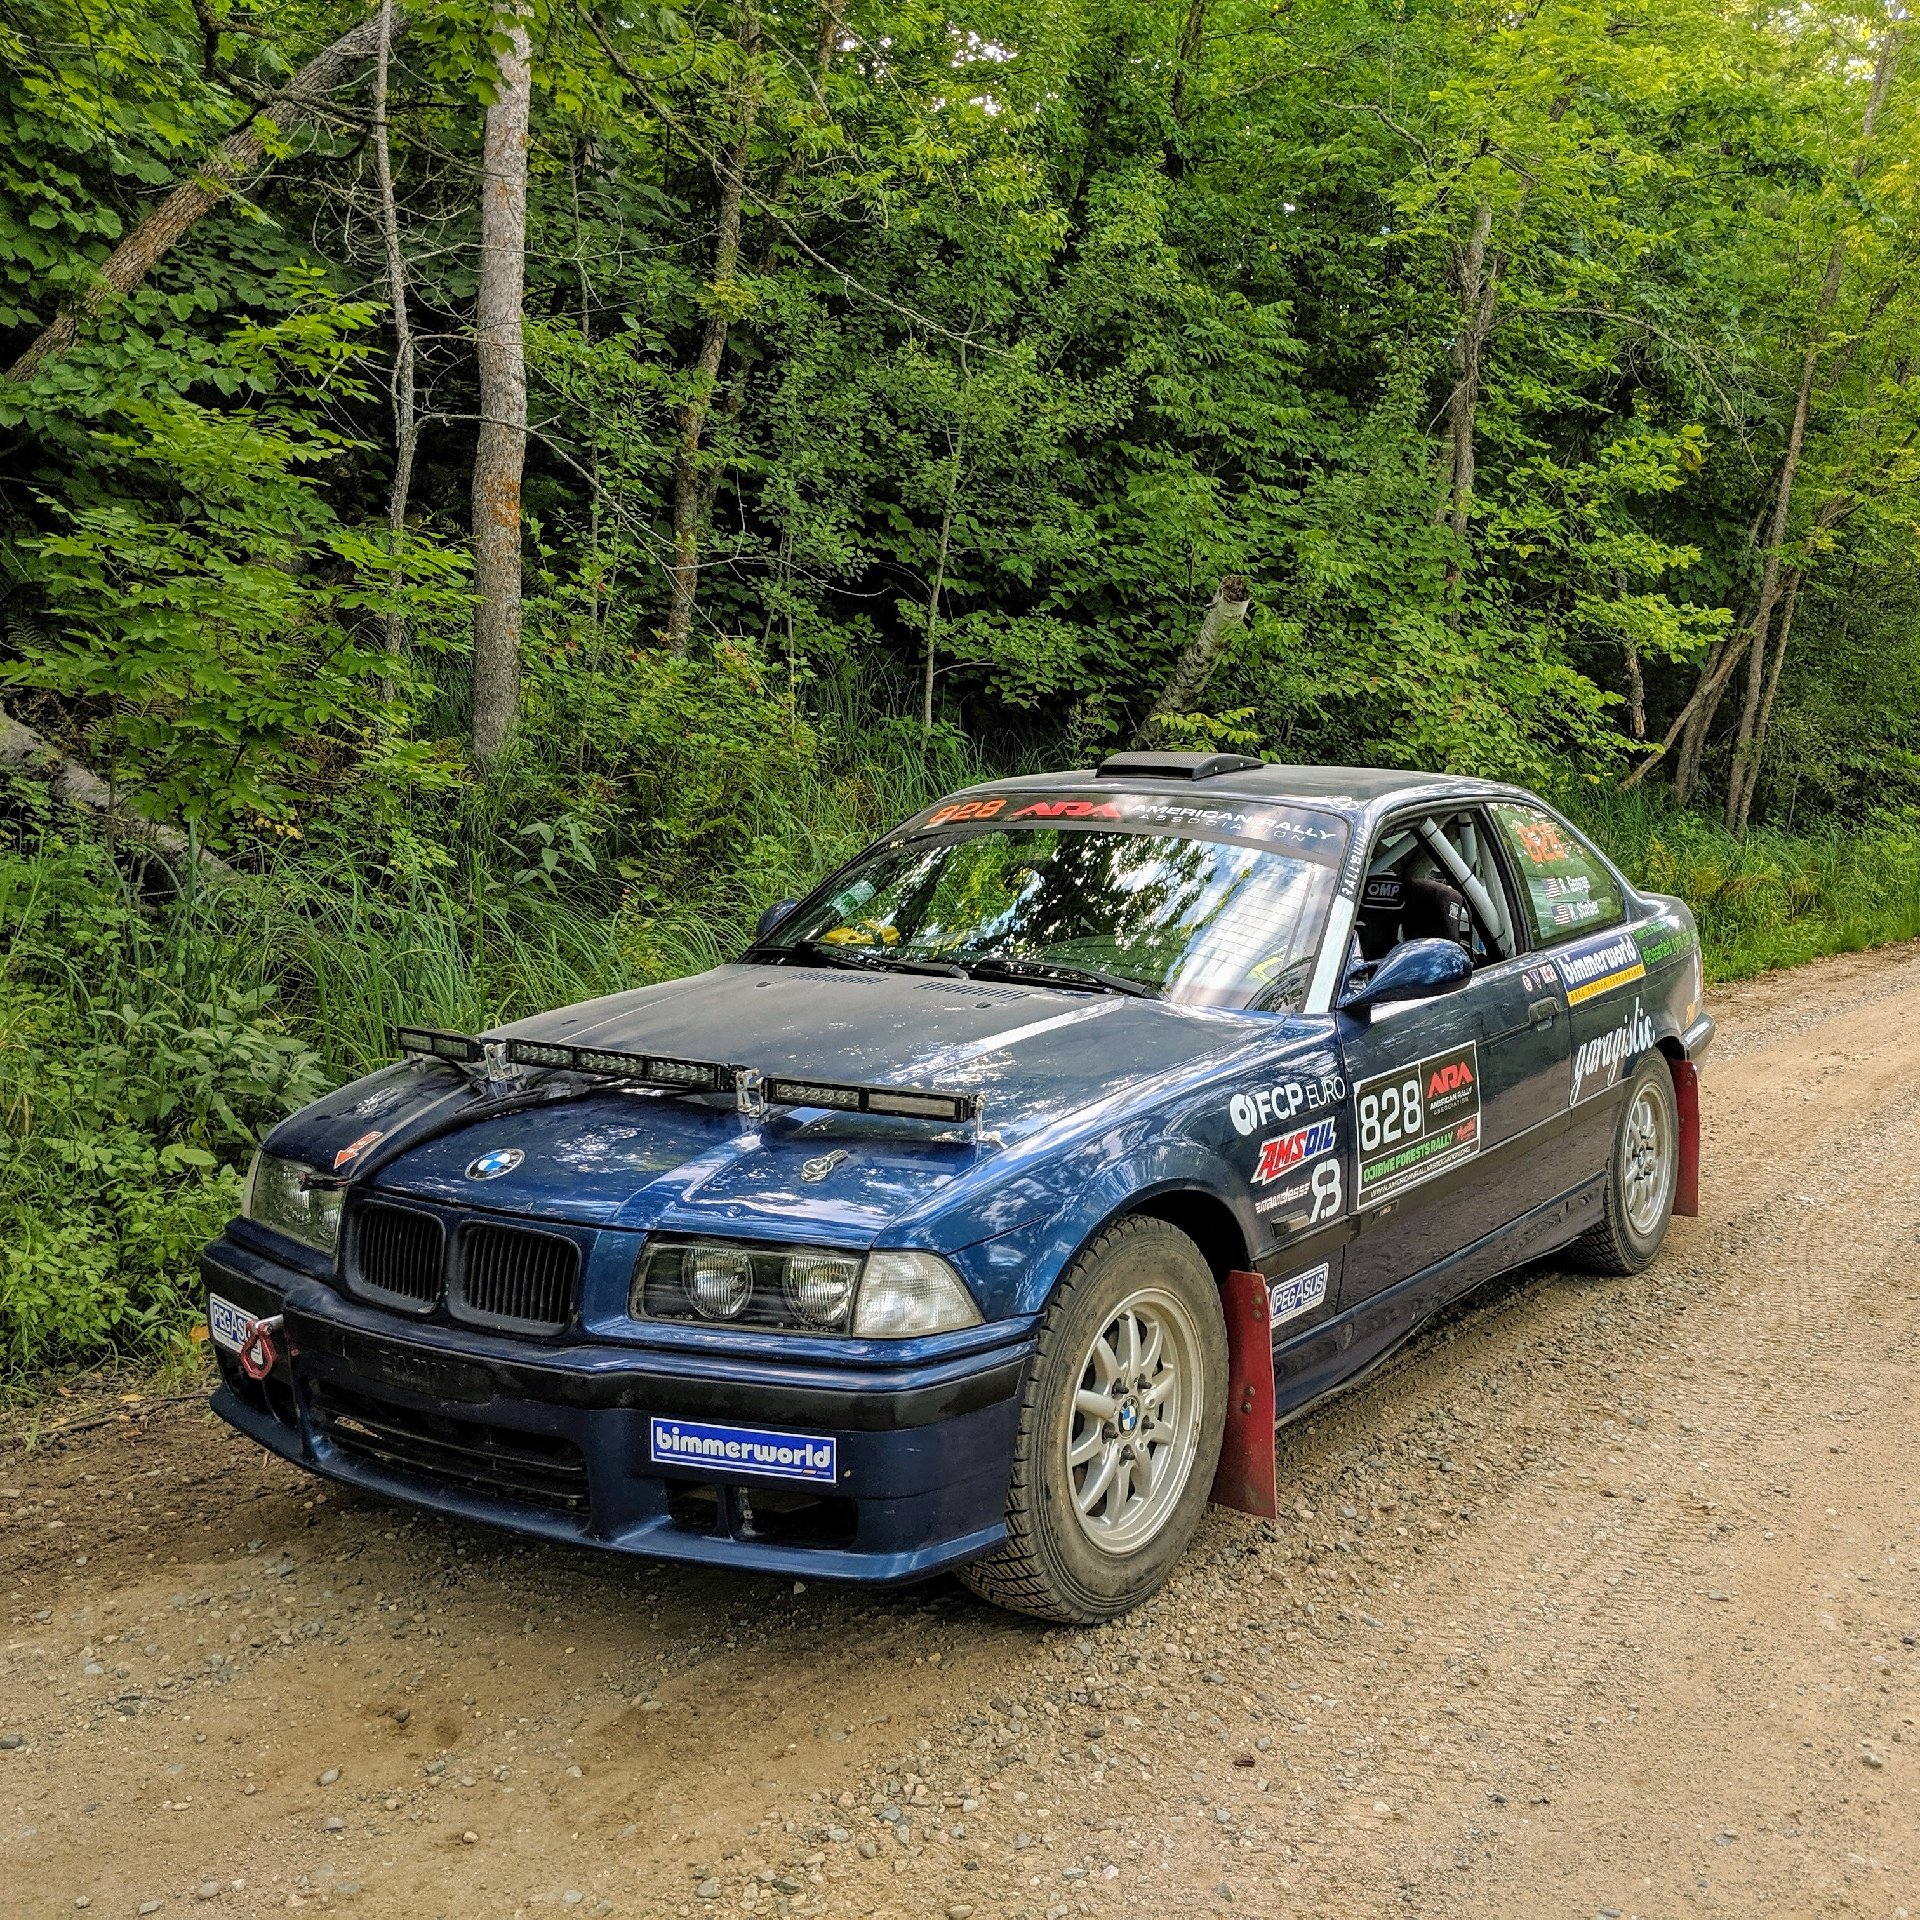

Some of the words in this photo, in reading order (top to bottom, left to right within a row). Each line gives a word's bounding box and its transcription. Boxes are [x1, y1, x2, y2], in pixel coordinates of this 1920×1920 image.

[928, 799, 1008, 824] 828
[1011, 801, 1121, 817] ARA
[1131, 805, 1254, 824] AMERICAN
[1258, 818, 1336, 839] RALLY
[1139, 815, 1306, 842] ASSOCIATION
[1368, 883, 1400, 897] OMP
[1557, 935, 1637, 984] bimmerworld
[1570, 997, 1655, 1105] garagistic
[1256, 1082, 1303, 1125] FCP
[1306, 1076, 1346, 1109] EURO
[1360, 1079, 1422, 1151] 828
[1430, 1092, 1457, 1110] AMERICAN
[1256, 1120, 1334, 1181] AMSOIL
[1363, 1156, 1395, 1183] OJIBWE
[1395, 1142, 1430, 1169] FORESTS
[1430, 1131, 1454, 1152] RALLY
[1274, 1273, 1324, 1314] PEGASUS
[656, 1426, 832, 1468] bimmerworld
